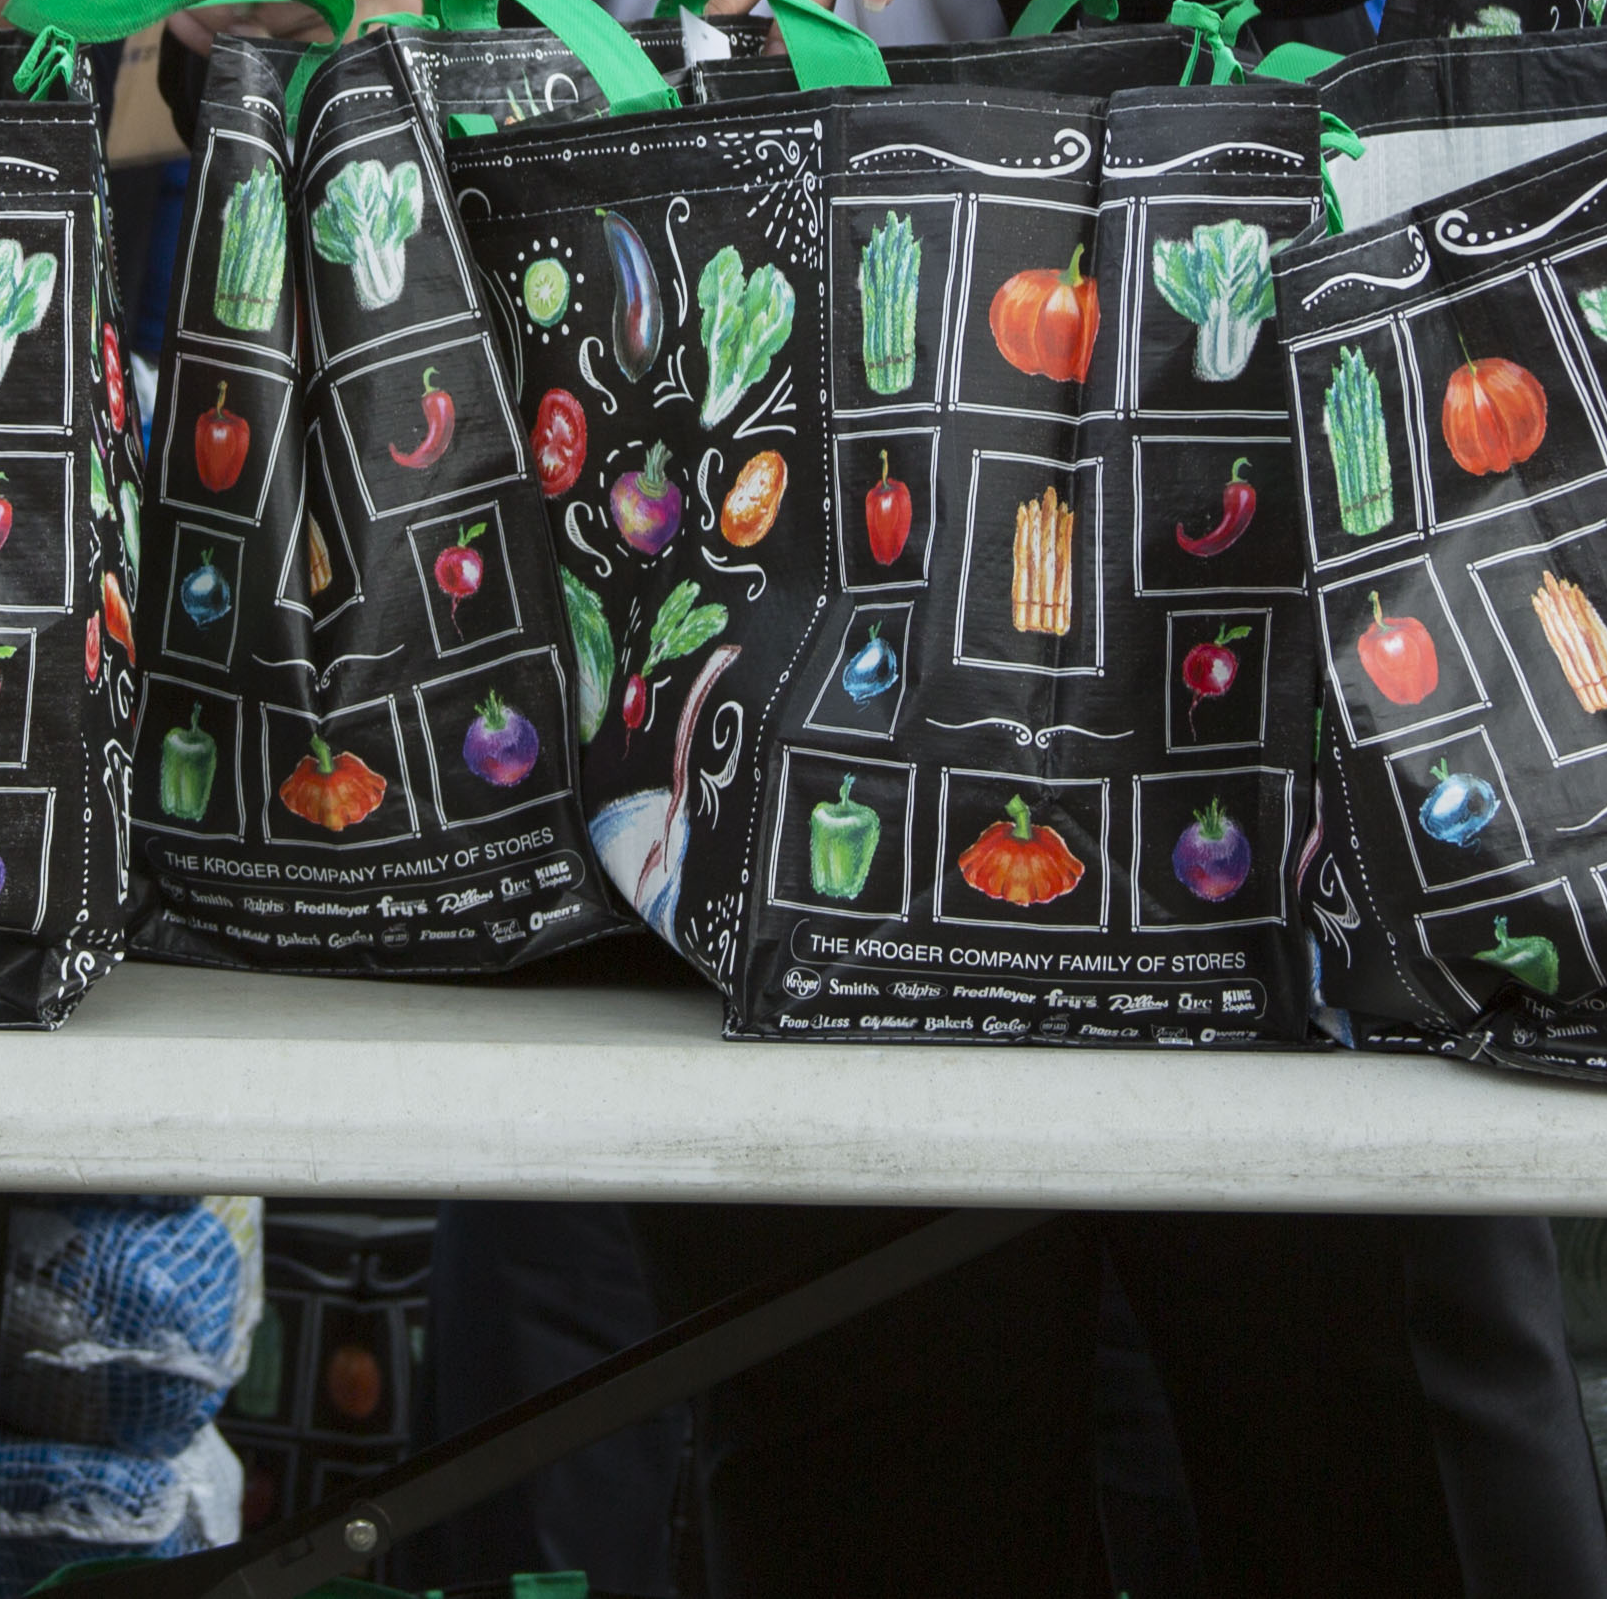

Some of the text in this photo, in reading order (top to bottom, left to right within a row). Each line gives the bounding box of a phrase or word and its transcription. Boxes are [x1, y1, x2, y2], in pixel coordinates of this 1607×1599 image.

[165, 827, 554, 885] THE KROGER COMPANY FAMILY OF STORES
[243, 897, 284, 914] Ralphs
[377, 896, 429, 917] fry's
[436, 889, 494, 914] Dillons
[535, 861, 570, 881] KING
[810, 934, 1246, 973] THE KROGER COMPANY FAMILY OF STORES
[786, 971, 819, 996] Kroger
[829, 978, 880, 996] Smith's
[894, 981, 942, 999] Ralphs
[1044, 988, 1097, 1009] fry's
[1108, 993, 1169, 1014] Dillons
[1222, 989, 1252, 1002] KING
[924, 1015, 974, 1032] Baker's
[1546, 1024, 1599, 1038] Smith's
